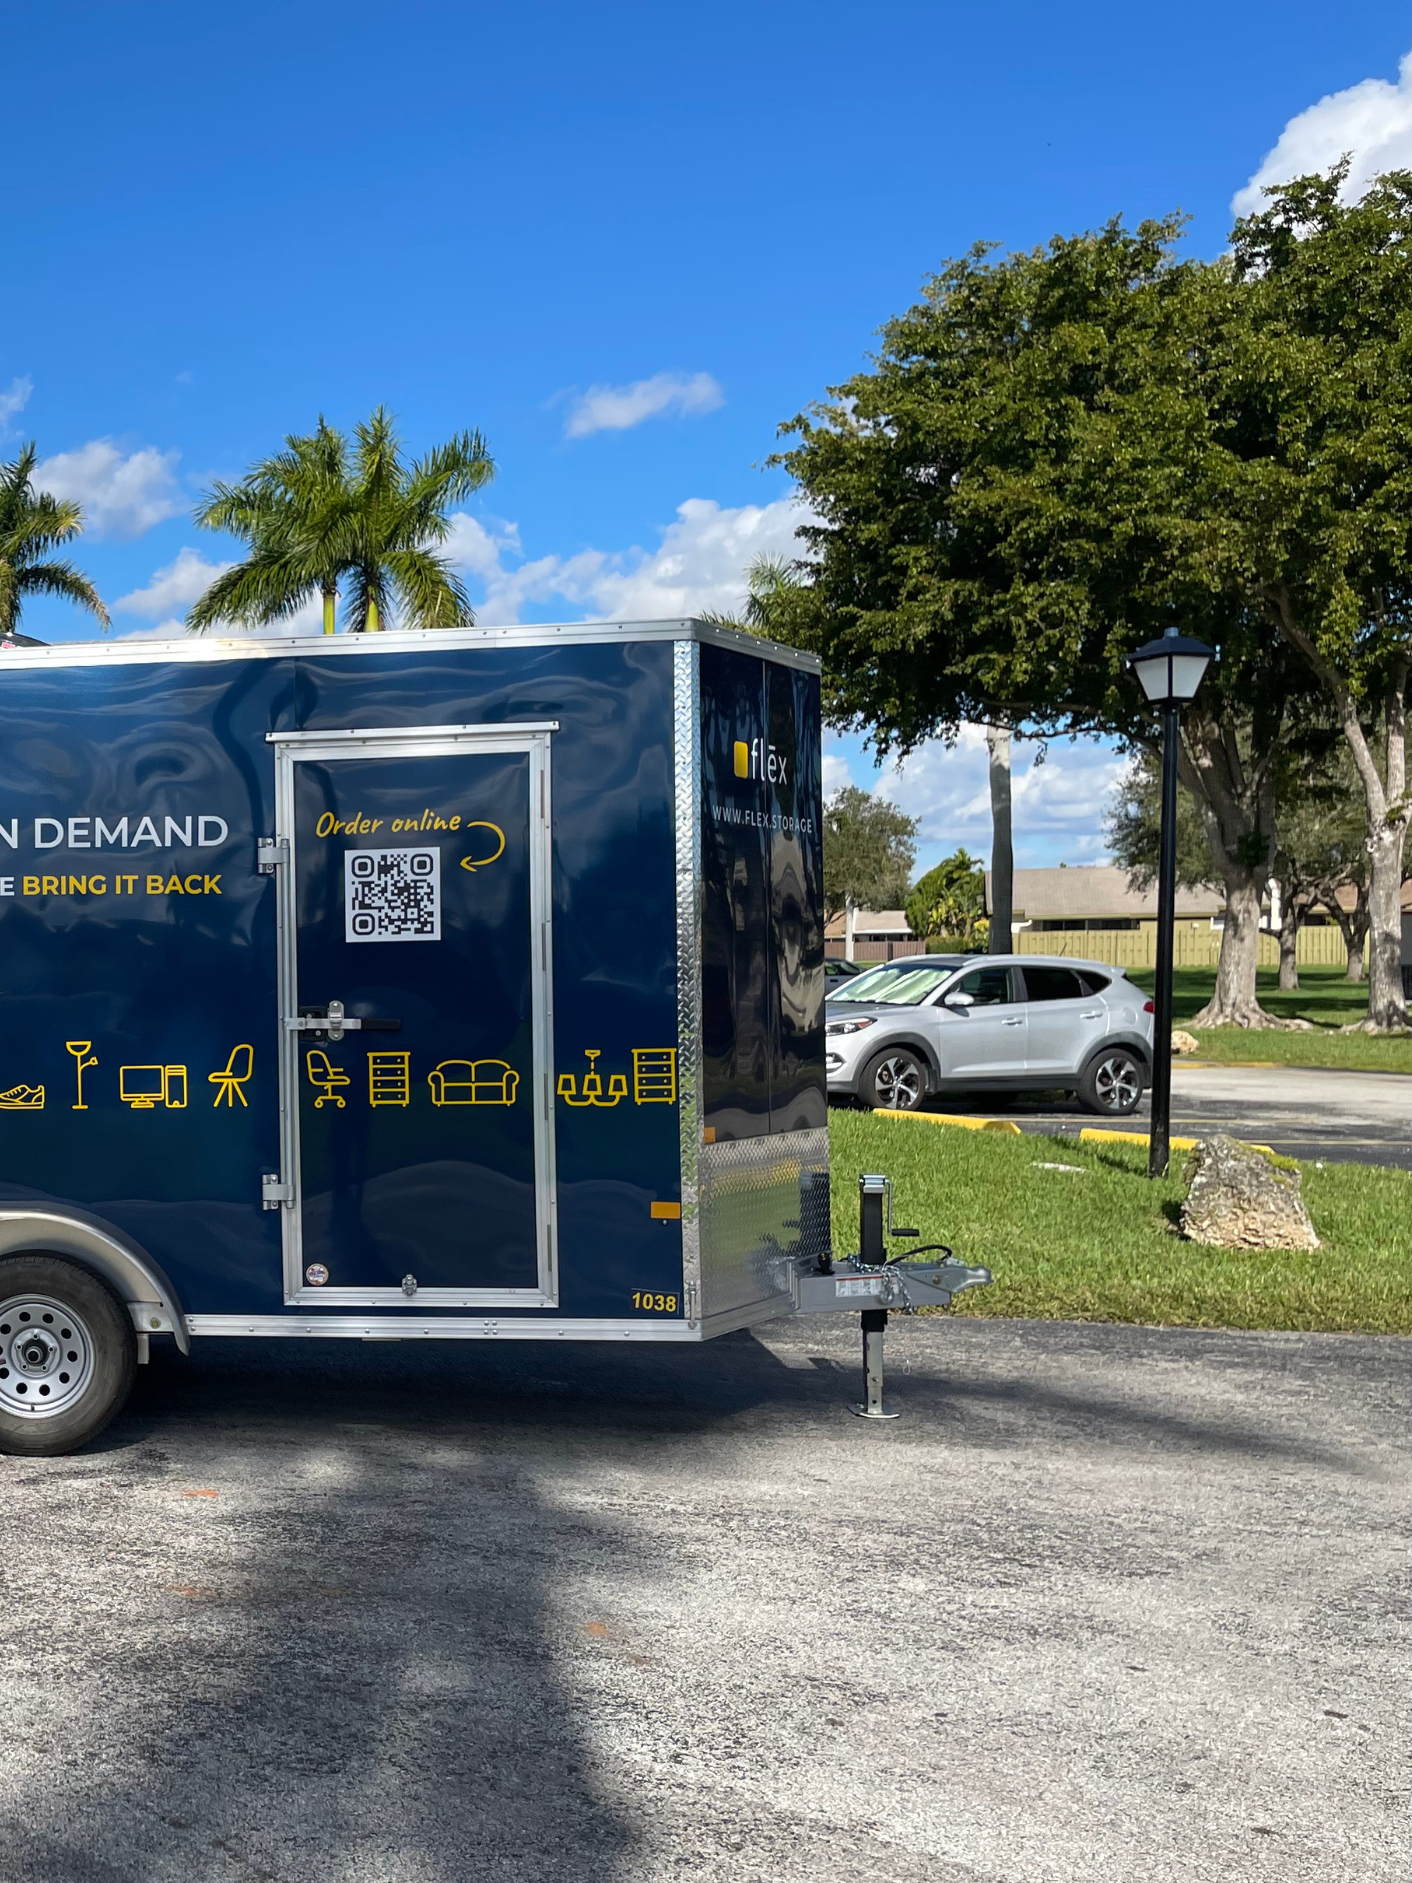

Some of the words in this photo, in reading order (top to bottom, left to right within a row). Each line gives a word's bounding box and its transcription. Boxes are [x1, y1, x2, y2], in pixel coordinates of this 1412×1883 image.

[34, 815, 229, 849] DEMAND
[316, 810, 384, 838] Order
[391, 808, 462, 833] online
[712, 805, 813, 834] WWW.FLEX.STORAGE
[23, 874, 107, 896] BRING
[115, 874, 139, 895] IT
[146, 873, 223, 895] BACK
[632, 1292, 677, 1312] 1038
